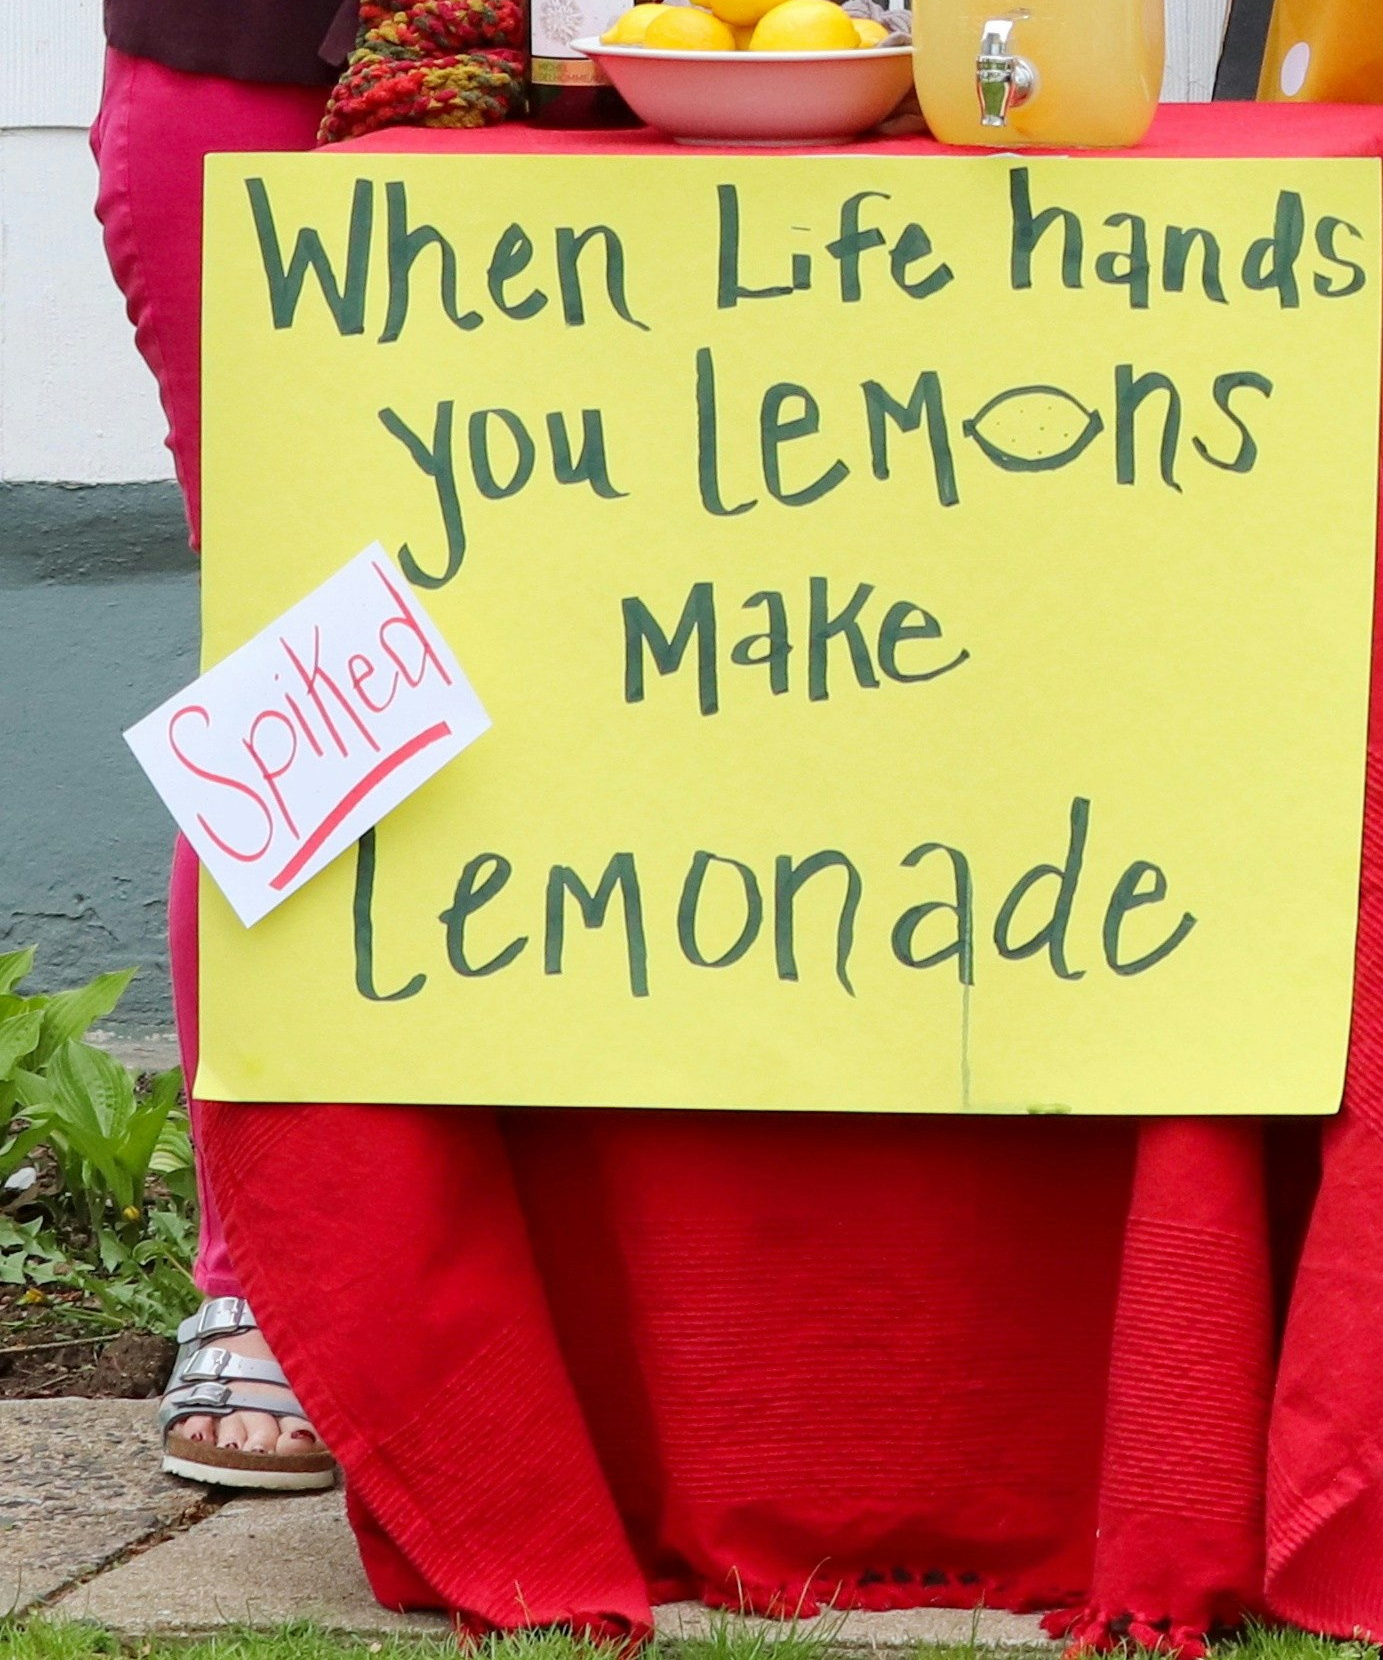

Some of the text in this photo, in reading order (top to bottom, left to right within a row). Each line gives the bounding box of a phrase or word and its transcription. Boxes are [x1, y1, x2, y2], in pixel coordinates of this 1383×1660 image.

[245, 167, 1365, 343] When Life hands
[379, 401, 628, 589] you
